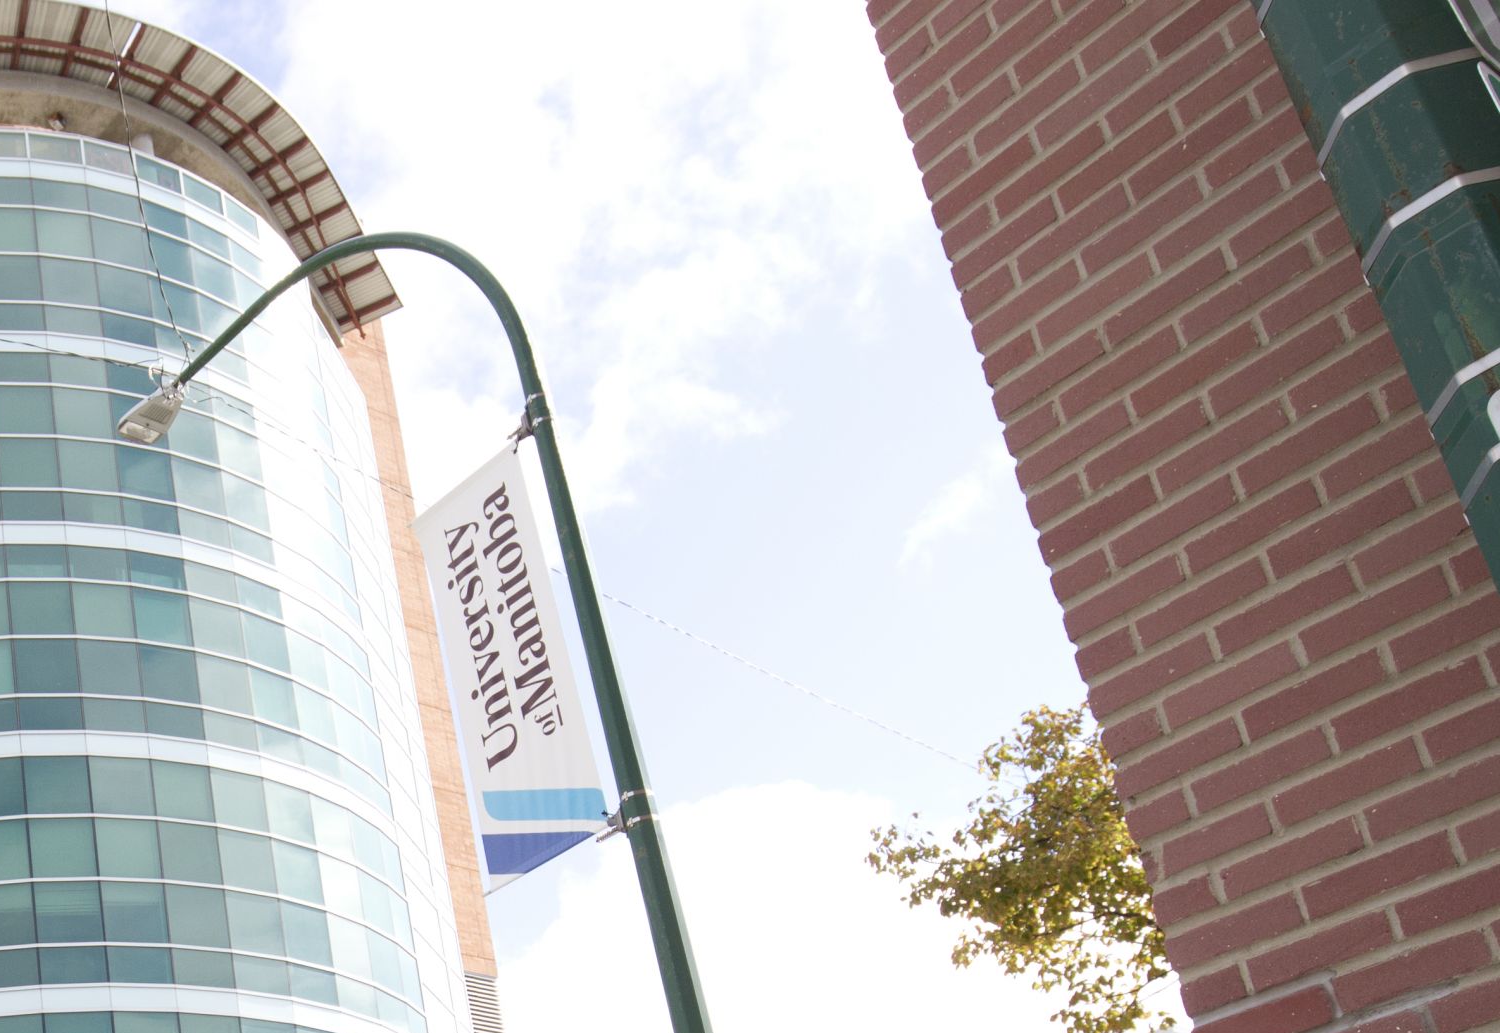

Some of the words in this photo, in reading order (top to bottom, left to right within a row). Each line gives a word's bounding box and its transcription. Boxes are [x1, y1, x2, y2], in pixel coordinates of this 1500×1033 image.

[444, 521, 518, 772] University
[481, 482, 557, 720] Manitoba
[533, 707, 562, 737] of
